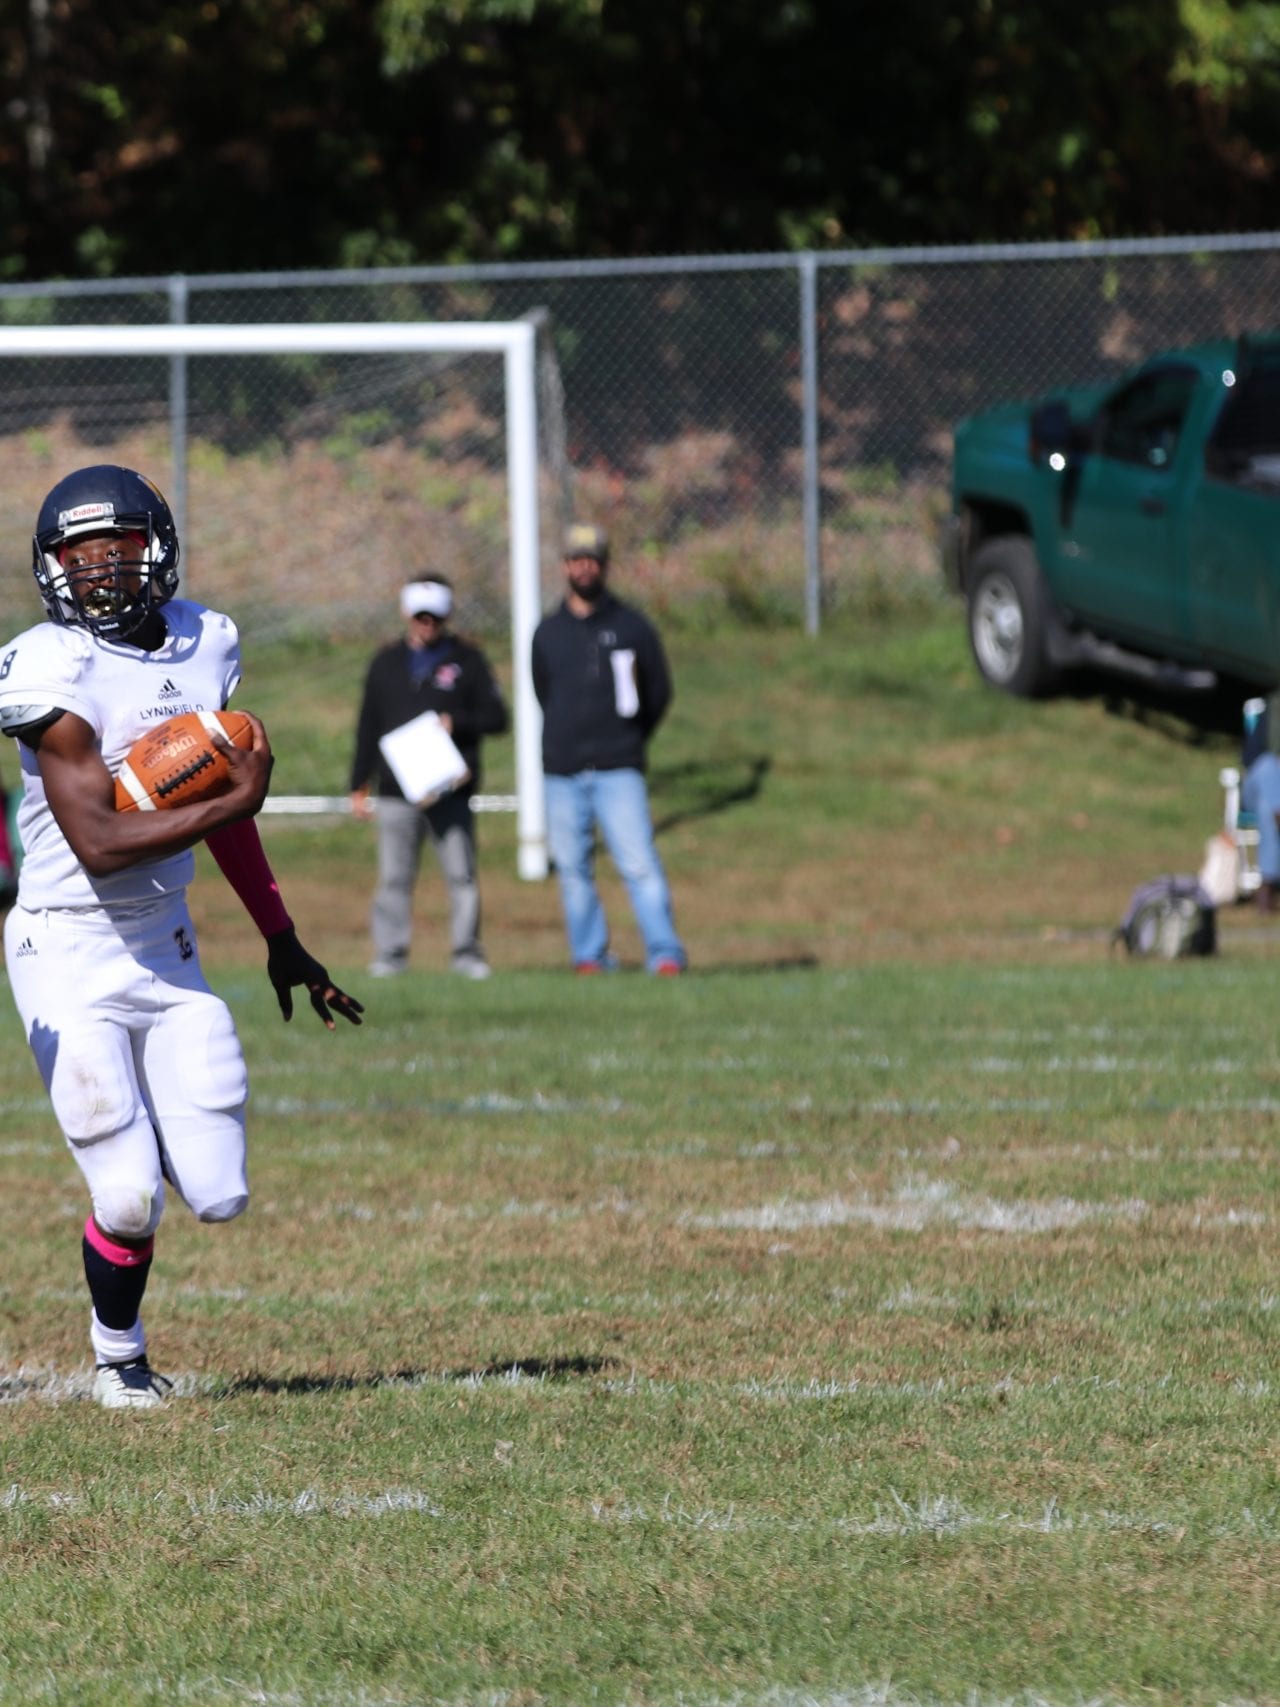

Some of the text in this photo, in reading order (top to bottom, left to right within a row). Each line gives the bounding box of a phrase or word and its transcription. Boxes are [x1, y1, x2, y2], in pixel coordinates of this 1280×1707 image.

[72, 504, 102, 518] Riddell
[0, 649, 17, 680] 8
[140, 703, 205, 721] LYNNFIELD
